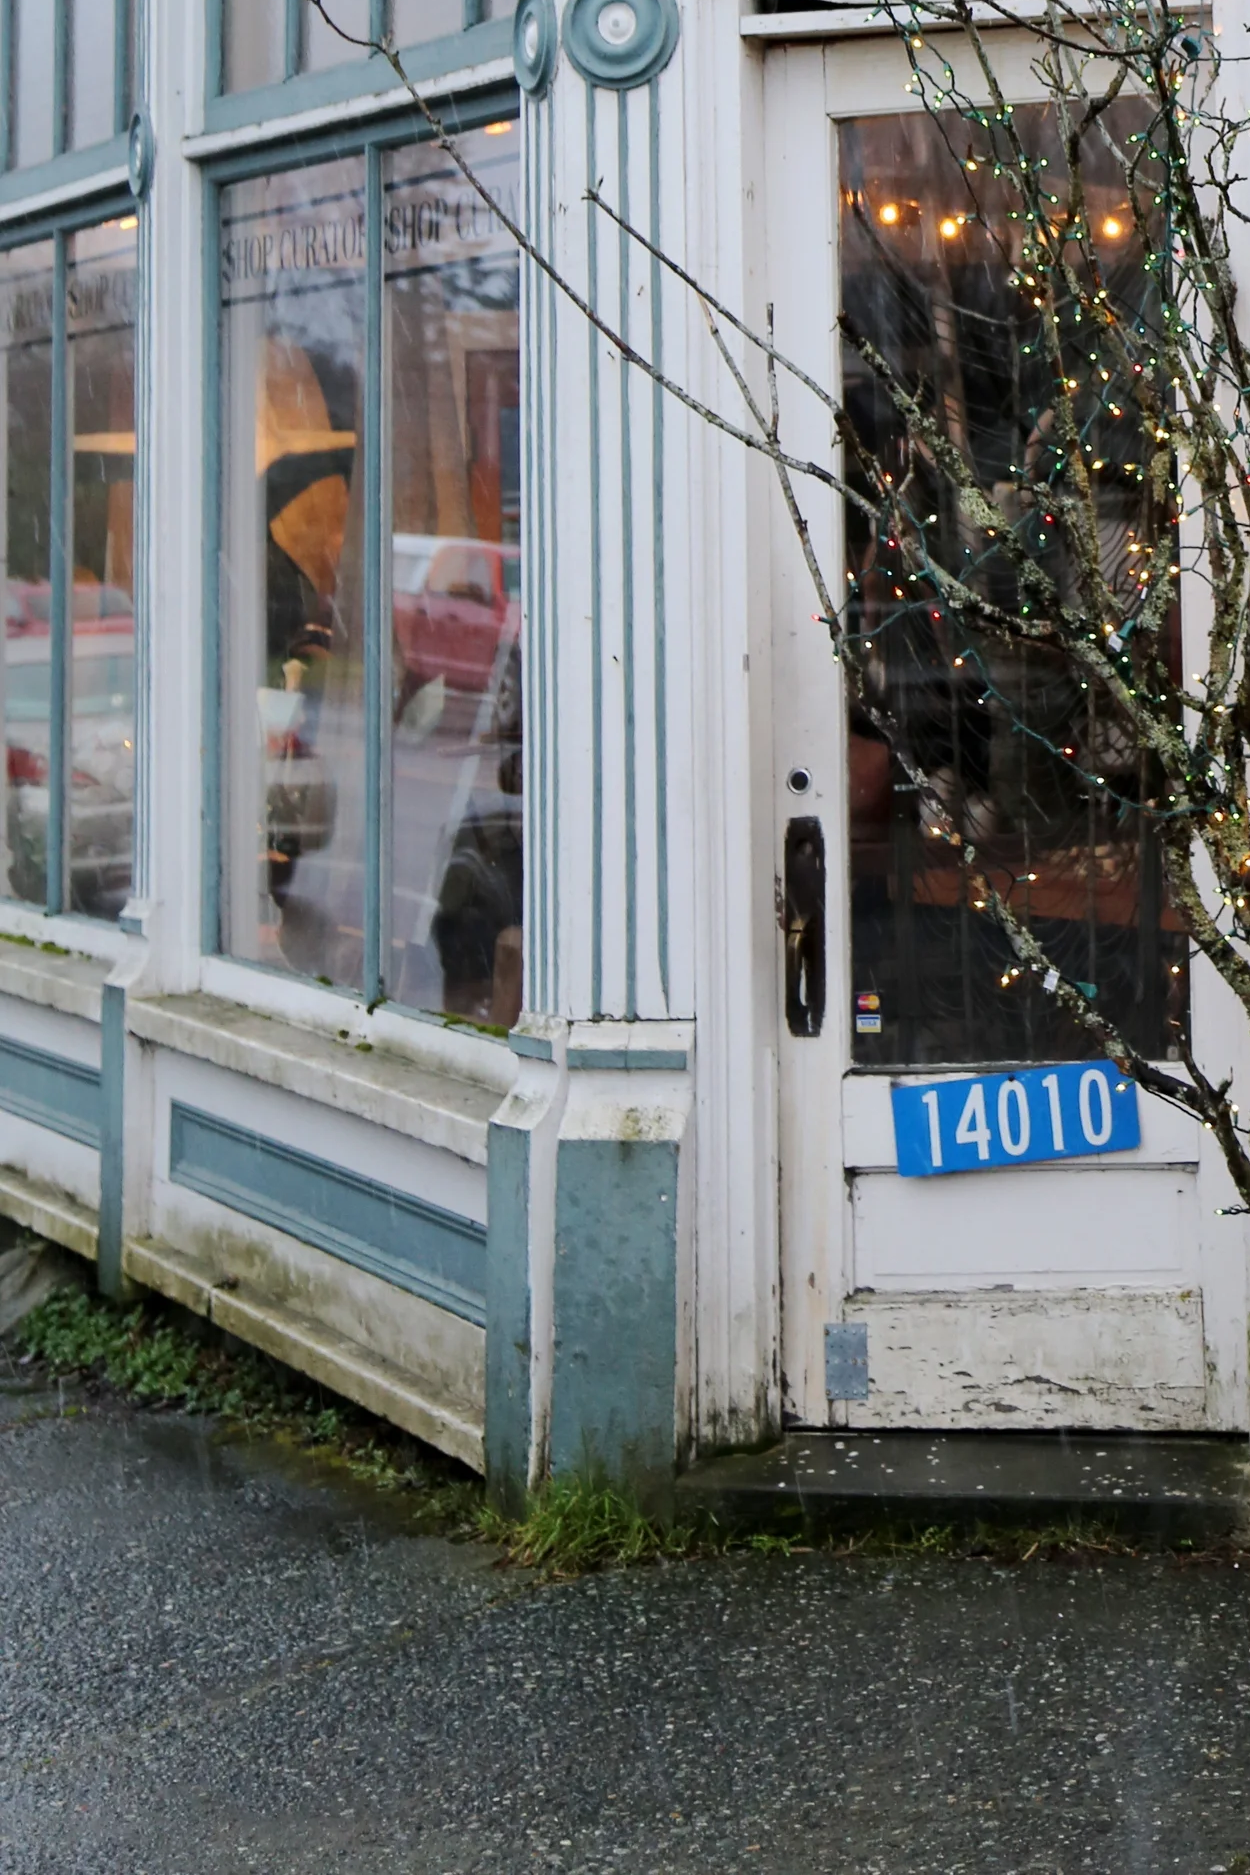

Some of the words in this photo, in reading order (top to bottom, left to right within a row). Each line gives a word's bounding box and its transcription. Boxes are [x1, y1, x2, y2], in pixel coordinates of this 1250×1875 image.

[386, 197, 448, 254] SHOP
[455, 178, 521, 241] CURA
[224, 234, 273, 280] SHOP
[922, 1068, 1113, 1168] 14010
